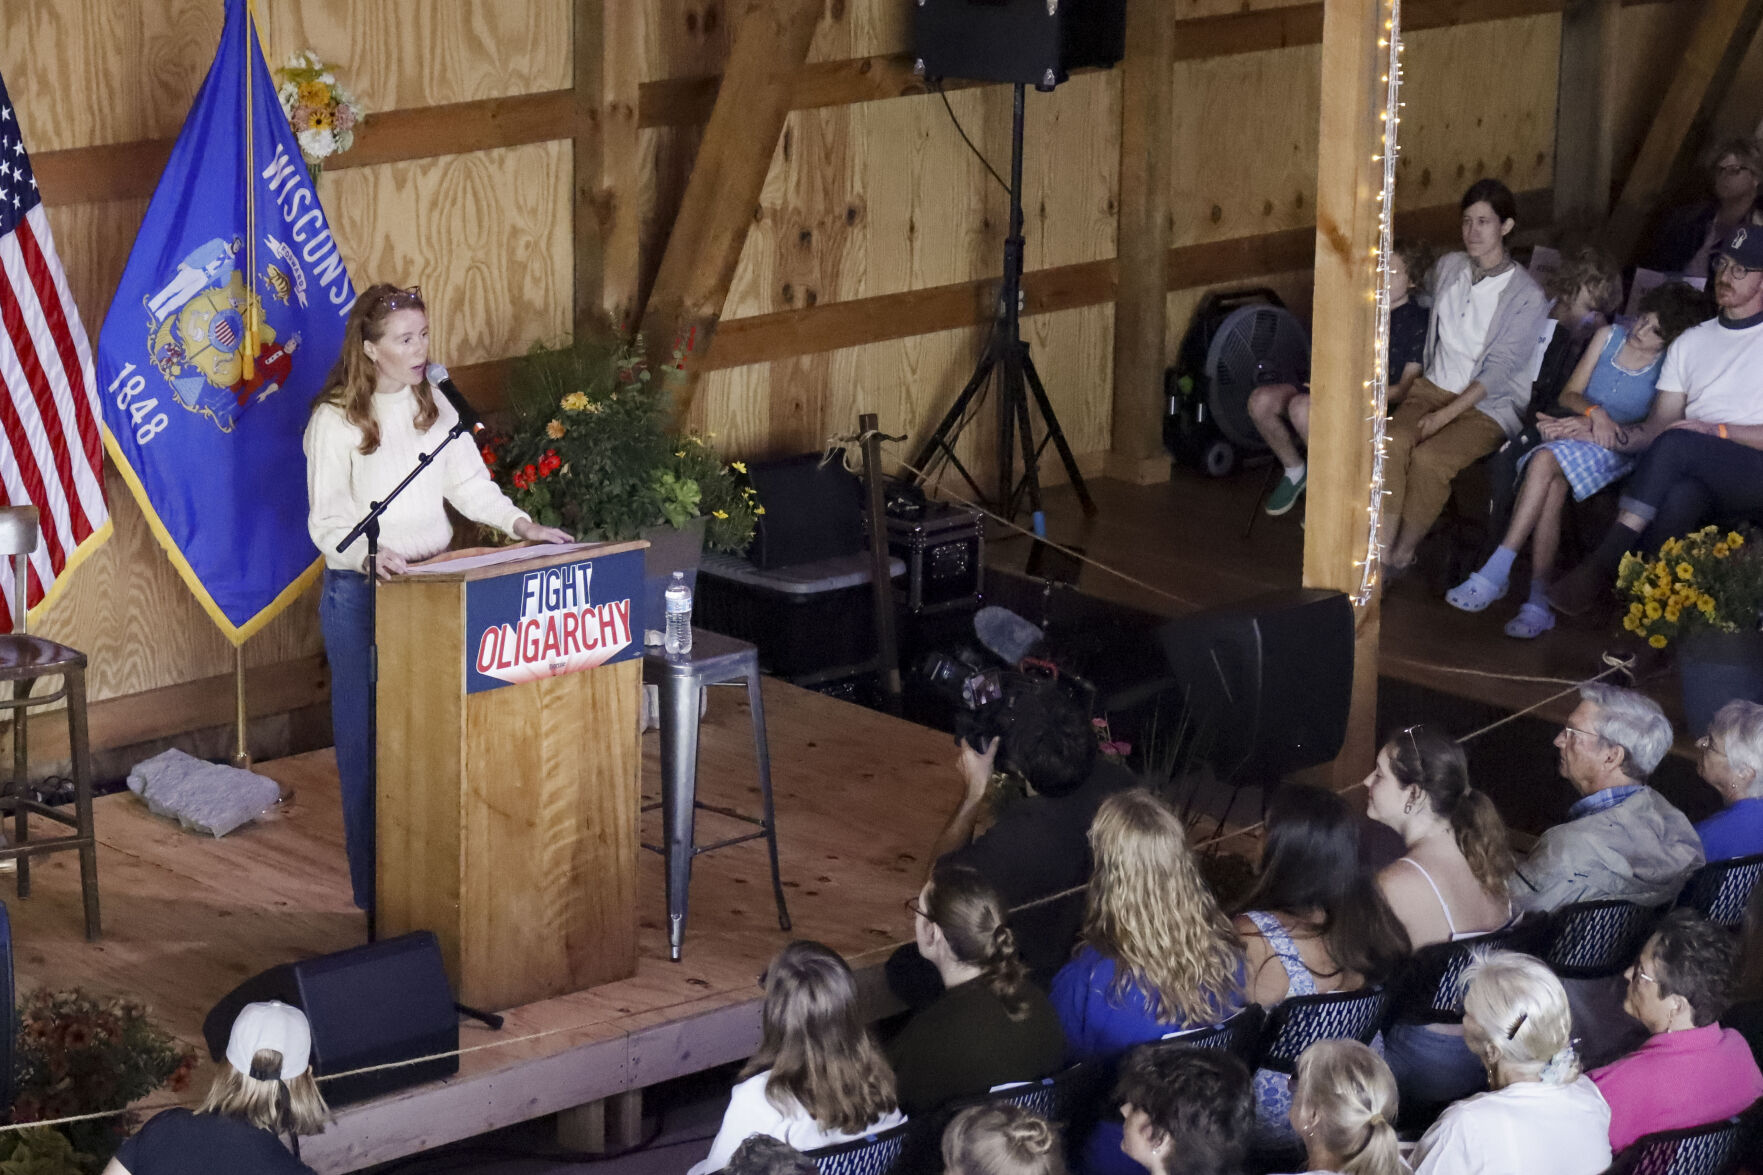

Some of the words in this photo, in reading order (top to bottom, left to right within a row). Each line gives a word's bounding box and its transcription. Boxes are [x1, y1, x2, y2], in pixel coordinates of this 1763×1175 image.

[262, 143, 357, 325] WISCONSI
[108, 362, 168, 445] 1848
[521, 562, 592, 617] FIGHT
[476, 599, 631, 673] OLIGARCHY
